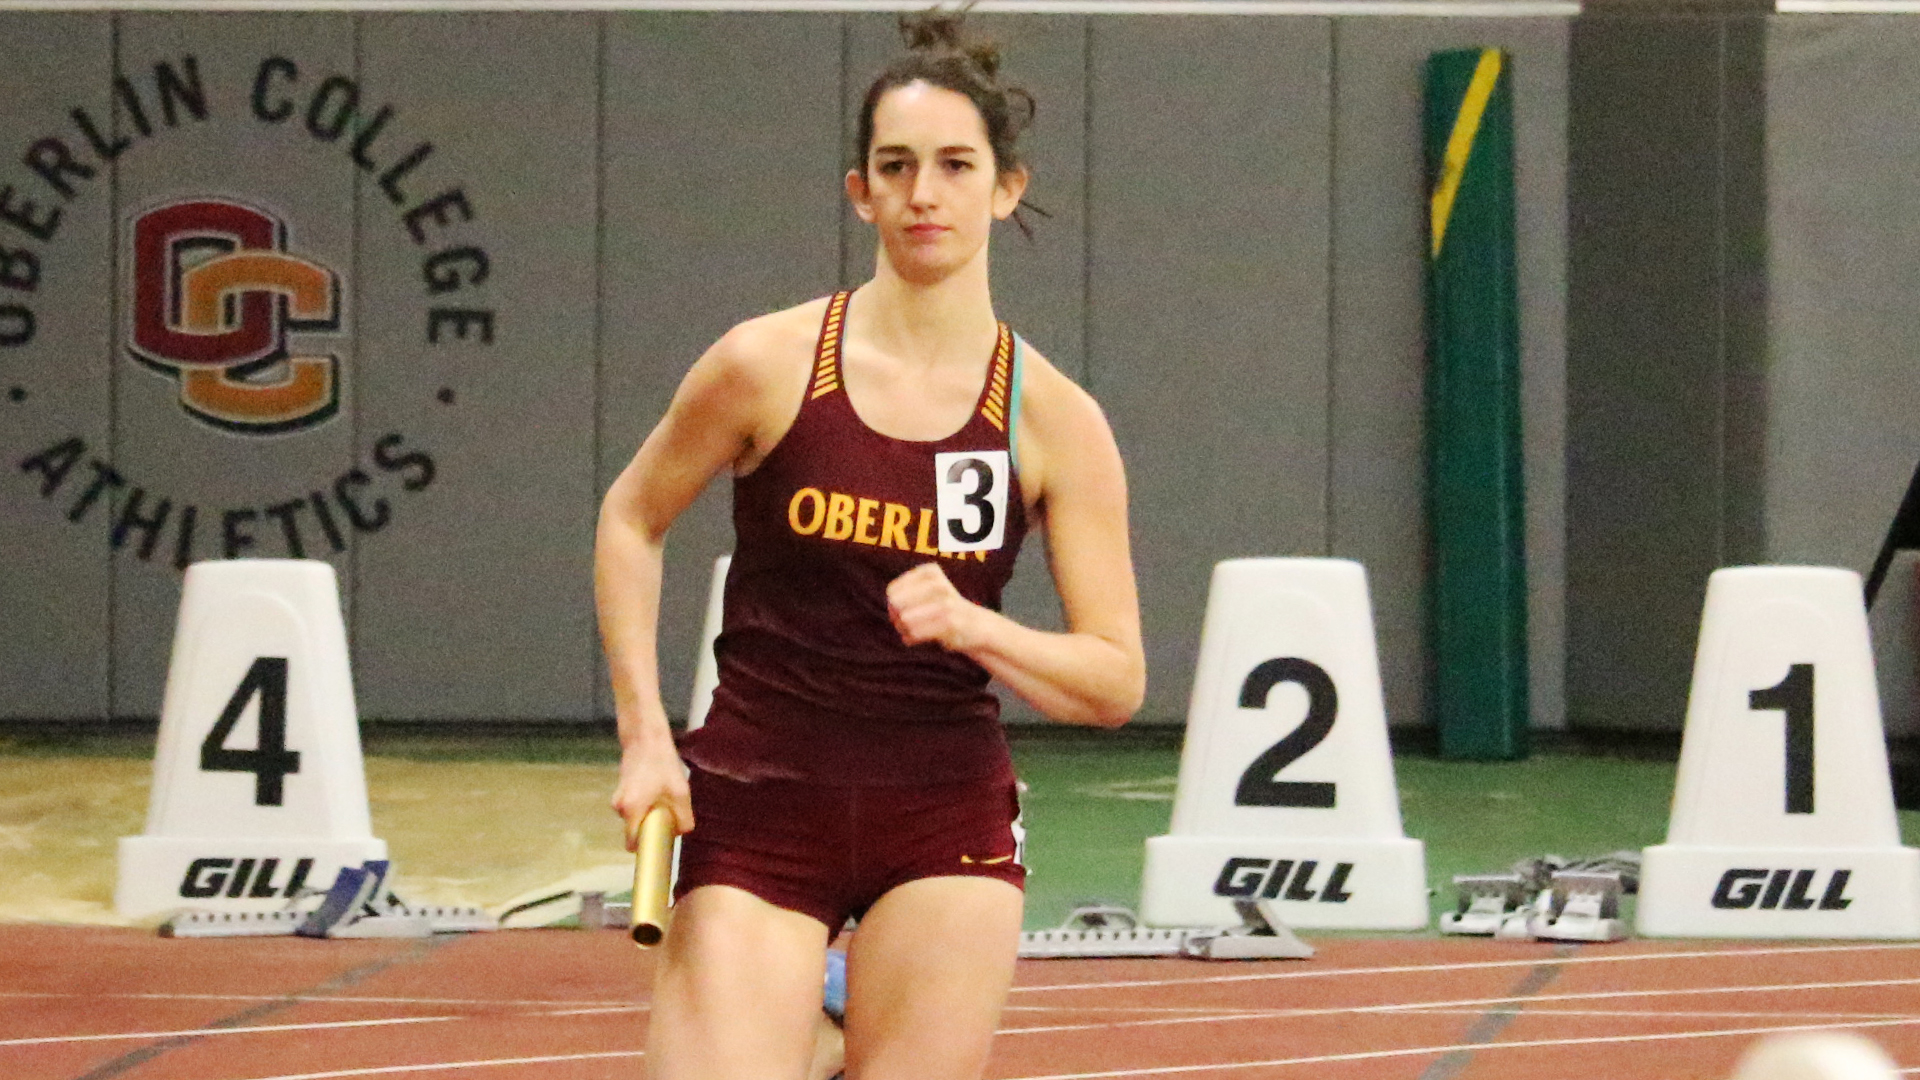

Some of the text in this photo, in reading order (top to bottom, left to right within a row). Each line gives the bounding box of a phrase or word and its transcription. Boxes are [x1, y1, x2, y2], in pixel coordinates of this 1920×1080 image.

[250, 56, 494, 346] COLLEGE
[20, 433, 436, 570] ATHLETICS
[788, 487, 987, 563] OBERL
[946, 458, 996, 544] 3
[199, 656, 301, 807] 4
[1234, 656, 1339, 808] 2
[1748, 663, 1816, 815] 1
[1213, 857, 1357, 904] GILL
[1710, 867, 1854, 911] GILL
